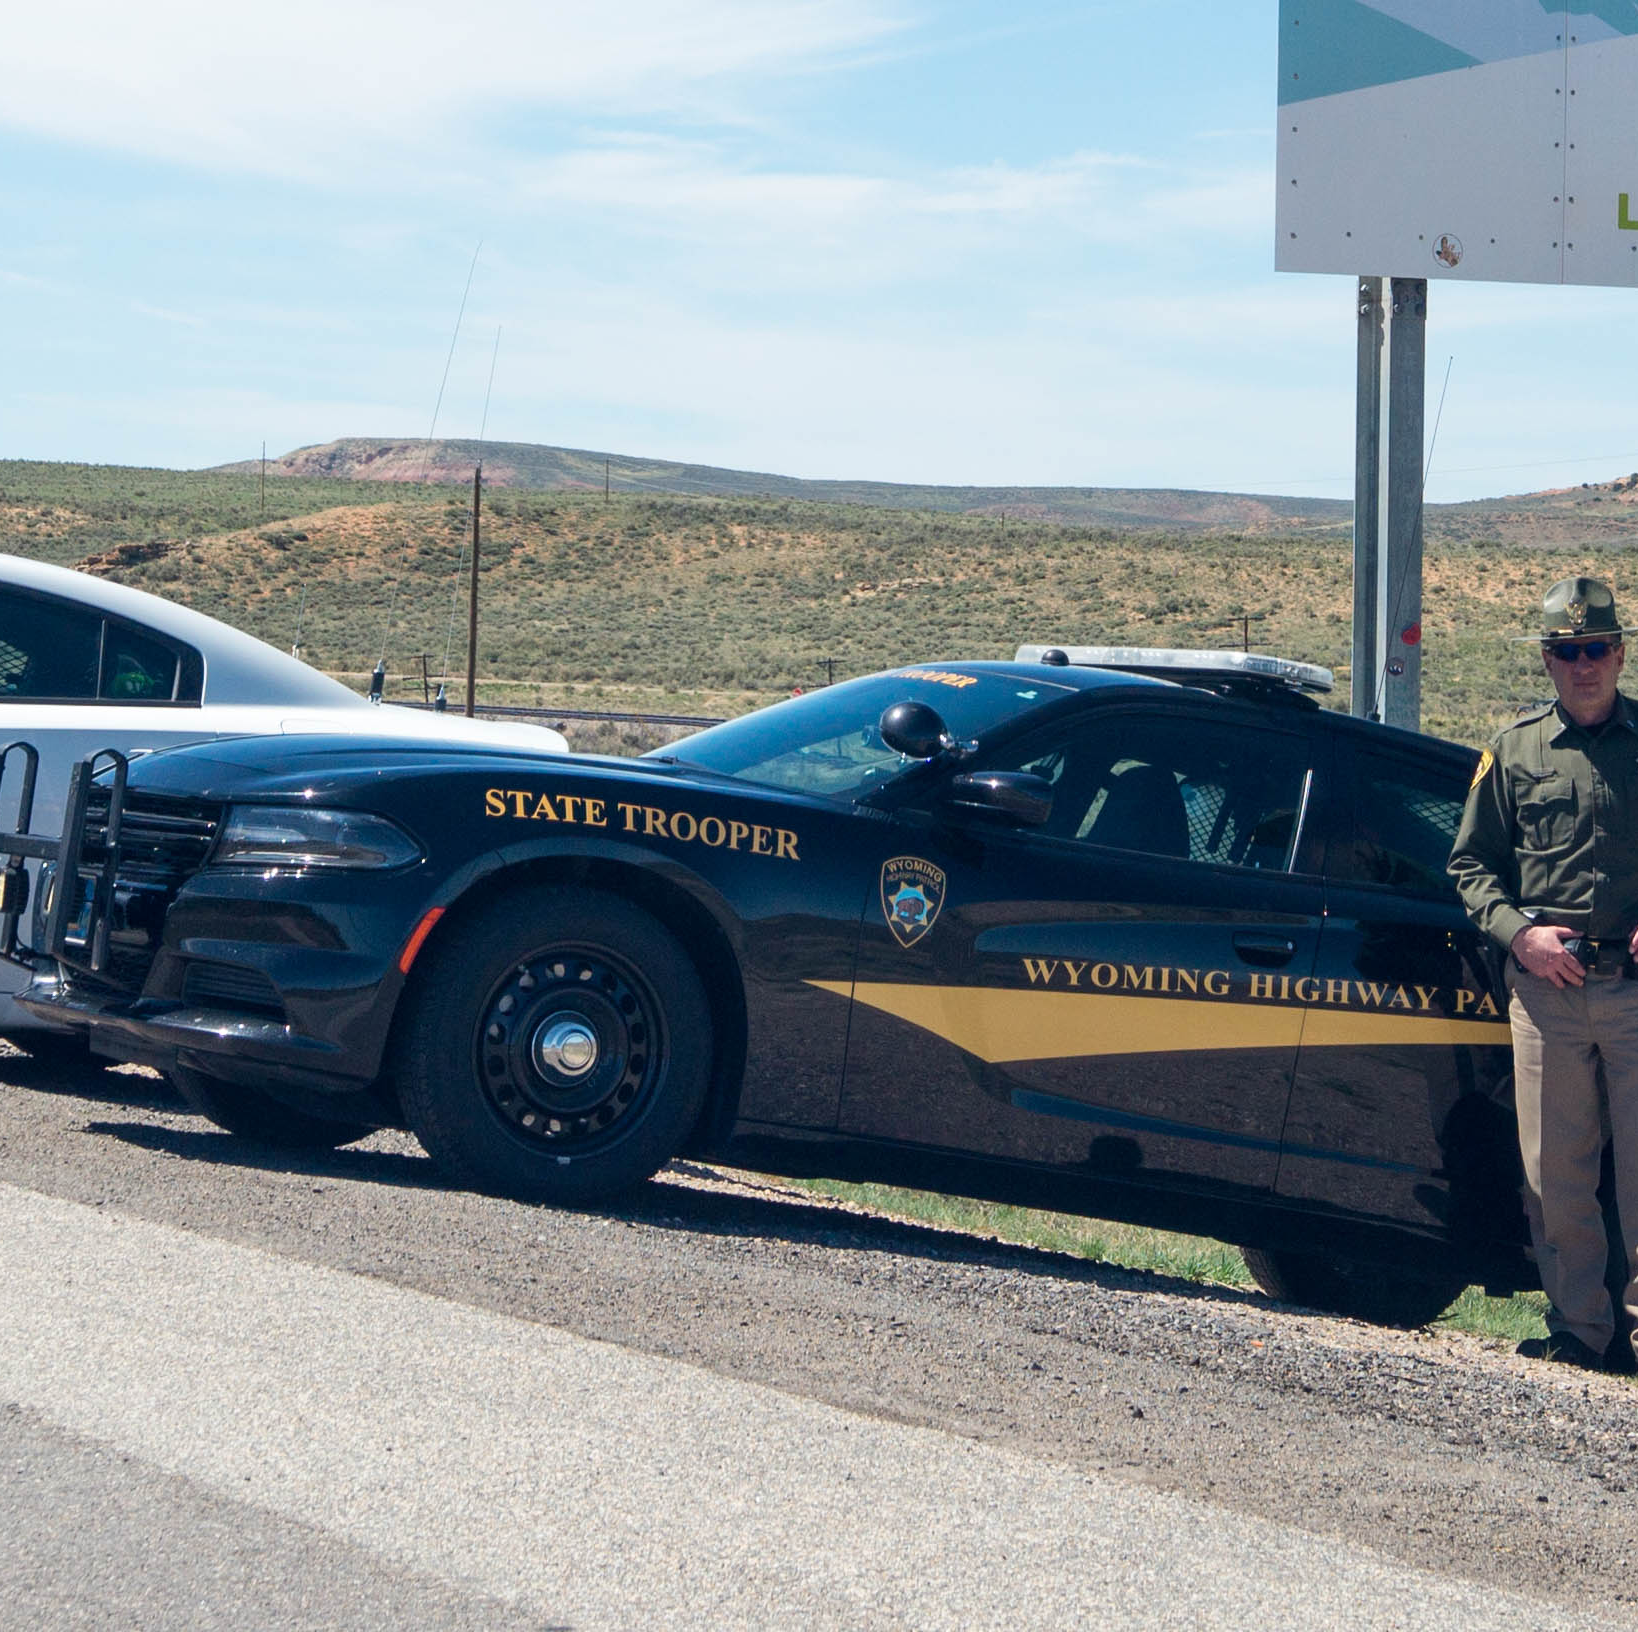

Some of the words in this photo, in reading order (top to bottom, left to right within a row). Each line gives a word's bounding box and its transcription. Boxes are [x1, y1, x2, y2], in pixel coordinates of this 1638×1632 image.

[485, 788, 608, 827] STATE
[617, 802, 801, 861] TROOPER
[887, 860, 942, 882] WYOMING
[1022, 958, 1231, 996] WYOMING
[1249, 972, 1439, 1011] HIGHWAY
